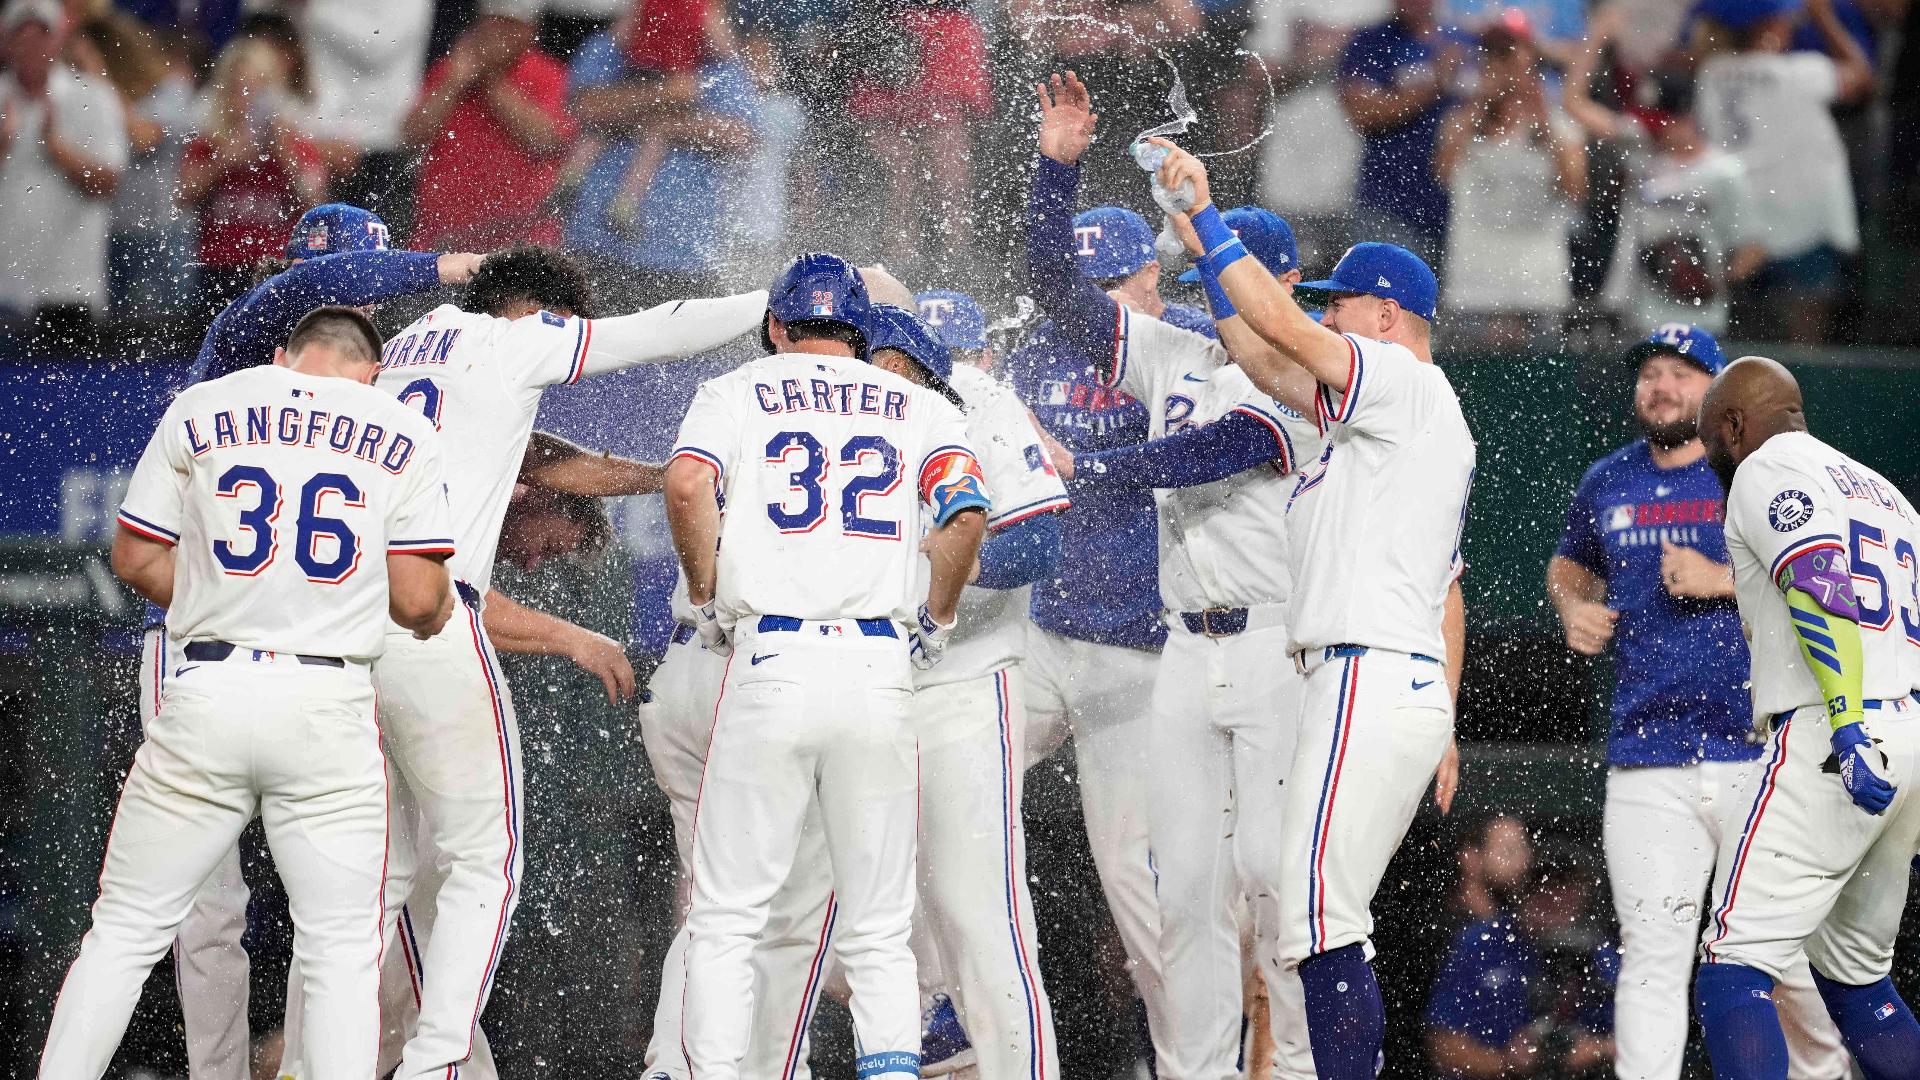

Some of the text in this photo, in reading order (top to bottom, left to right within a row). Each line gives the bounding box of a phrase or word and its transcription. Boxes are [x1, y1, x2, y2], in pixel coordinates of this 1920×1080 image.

[367, 221, 391, 250] T
[1074, 226, 1104, 257] T
[811, 290, 834, 306] 32
[920, 299, 954, 327] T
[380, 328, 462, 372] URAN
[1660, 322, 1690, 346] T
[754, 378, 909, 421] CARTER
[184, 405, 416, 476] LANGFORD
[763, 430, 906, 542] 32
[1825, 464, 1914, 525] GARC
[213, 464, 366, 585] 36
[1769, 490, 1814, 531] ENERGY TRANSFER
[1849, 518, 1920, 648] 53
[1828, 695, 1847, 718] 53
[1845, 752, 1856, 790] adidas
[857, 1058, 886, 1072] utely
